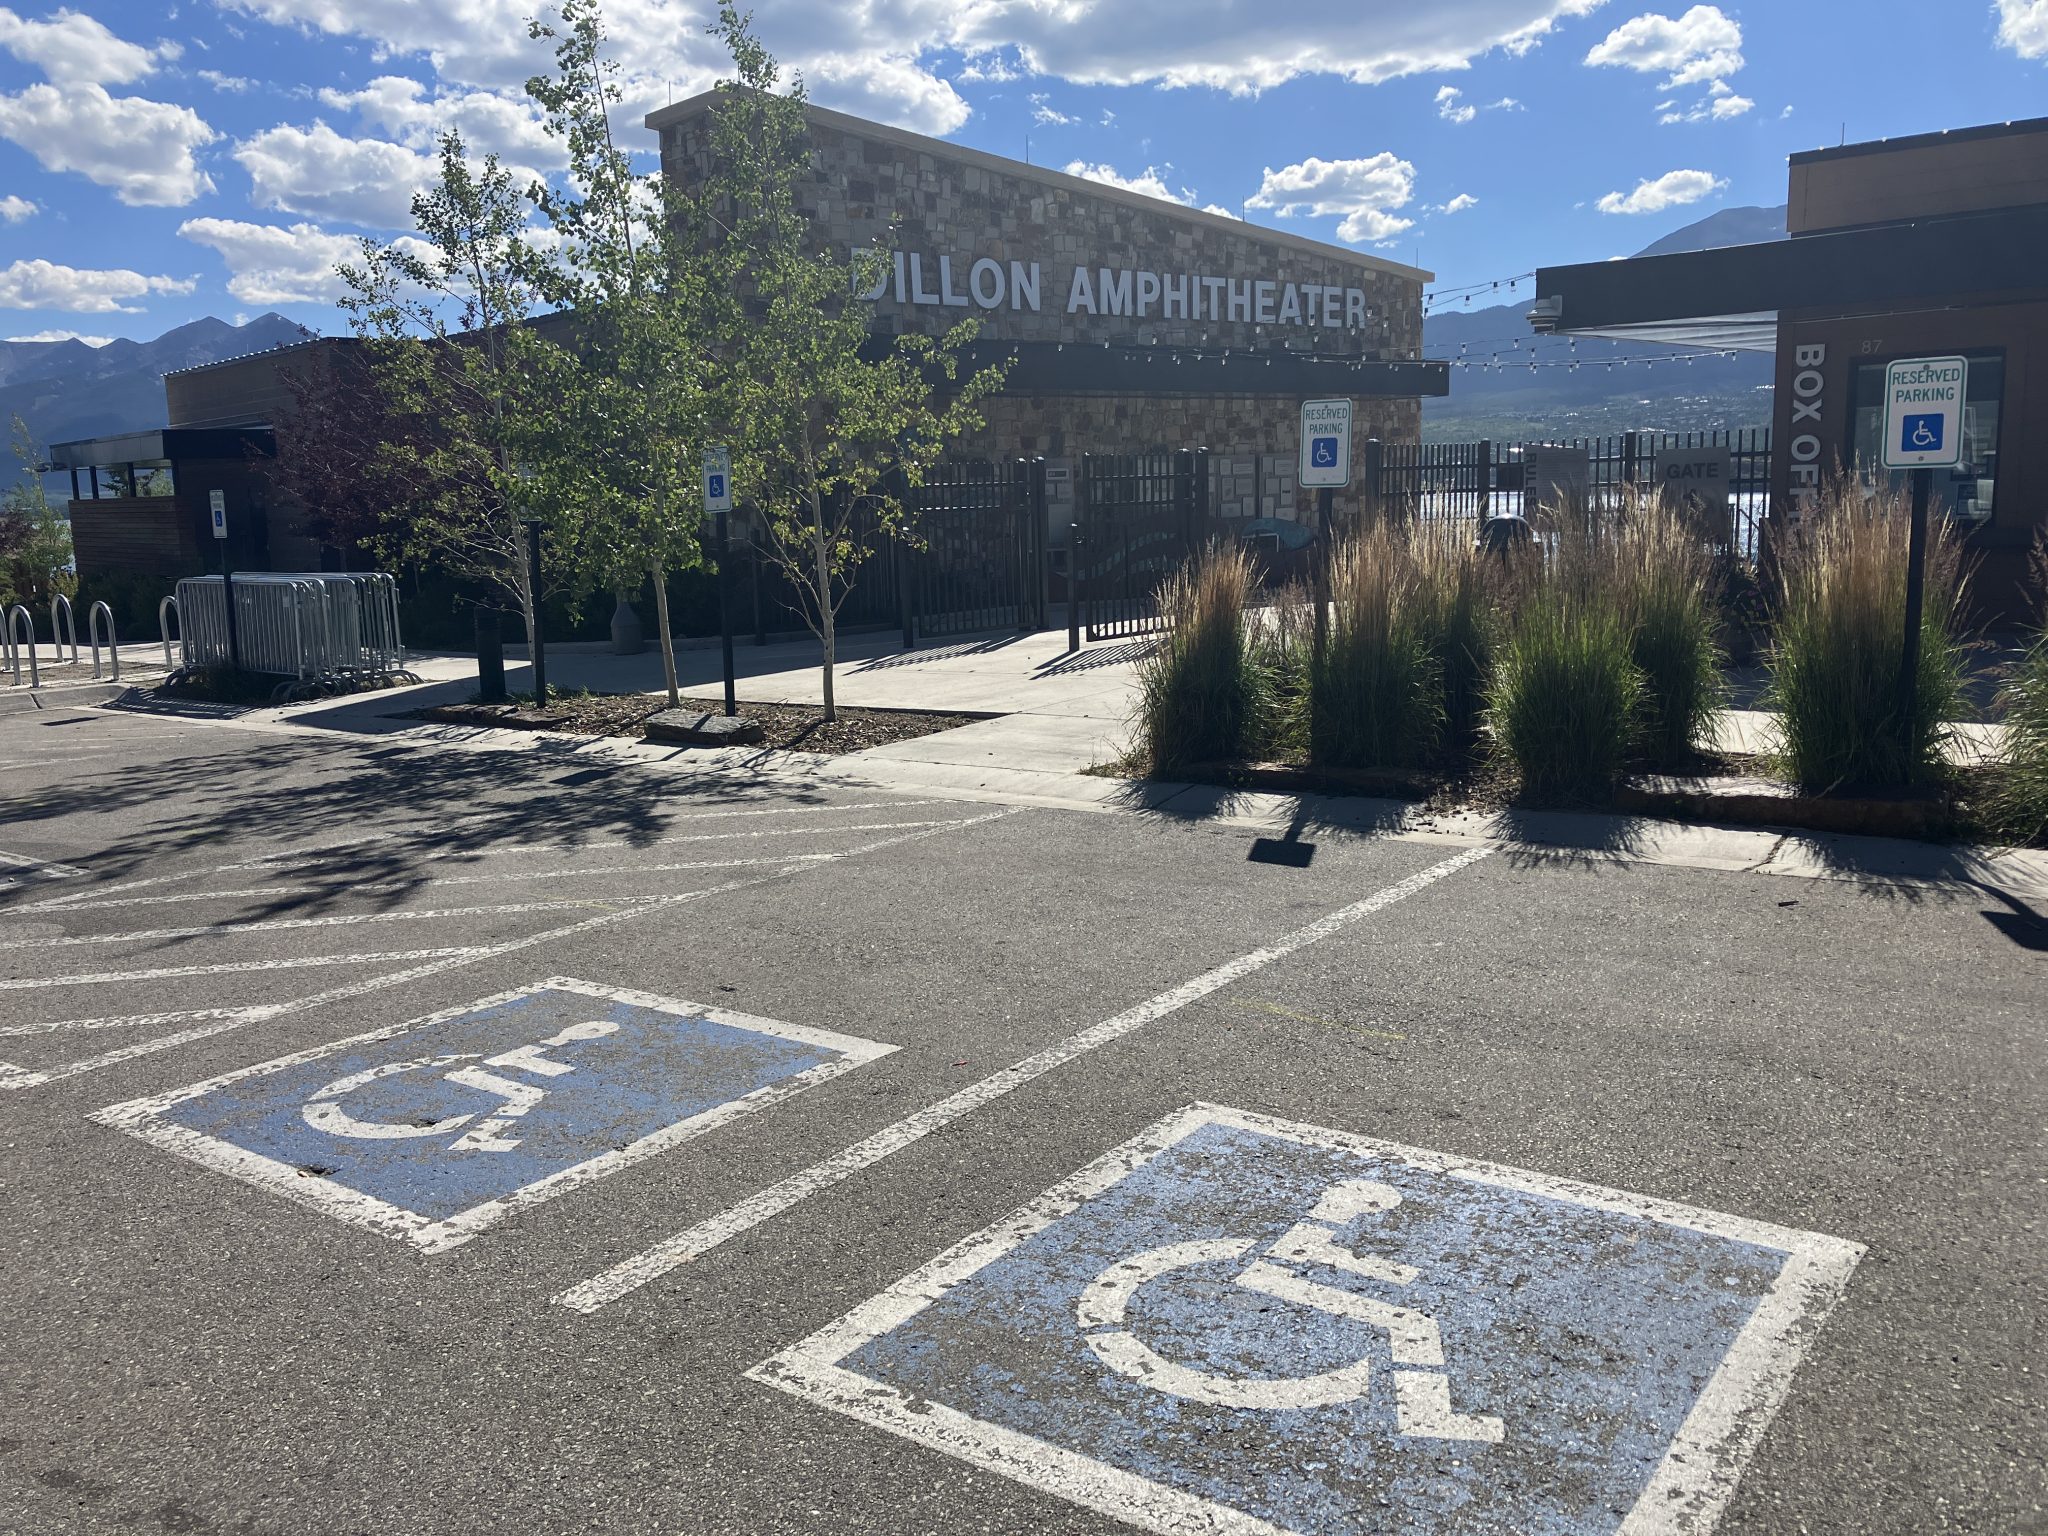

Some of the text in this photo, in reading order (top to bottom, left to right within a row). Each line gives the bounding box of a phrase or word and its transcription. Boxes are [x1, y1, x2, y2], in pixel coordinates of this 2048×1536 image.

[1067, 266, 1366, 329] AMPHITHEATER
[1861, 340, 1883, 354] 87
[1891, 368, 1960, 386] RESERVED
[1895, 387, 1955, 403] PARKING
[1305, 407, 1348, 420] RESERVED
[1309, 422, 1343, 435] PARKING
[1788, 343, 1826, 524] BOX OFF
[1666, 462, 1719, 479] GATE
